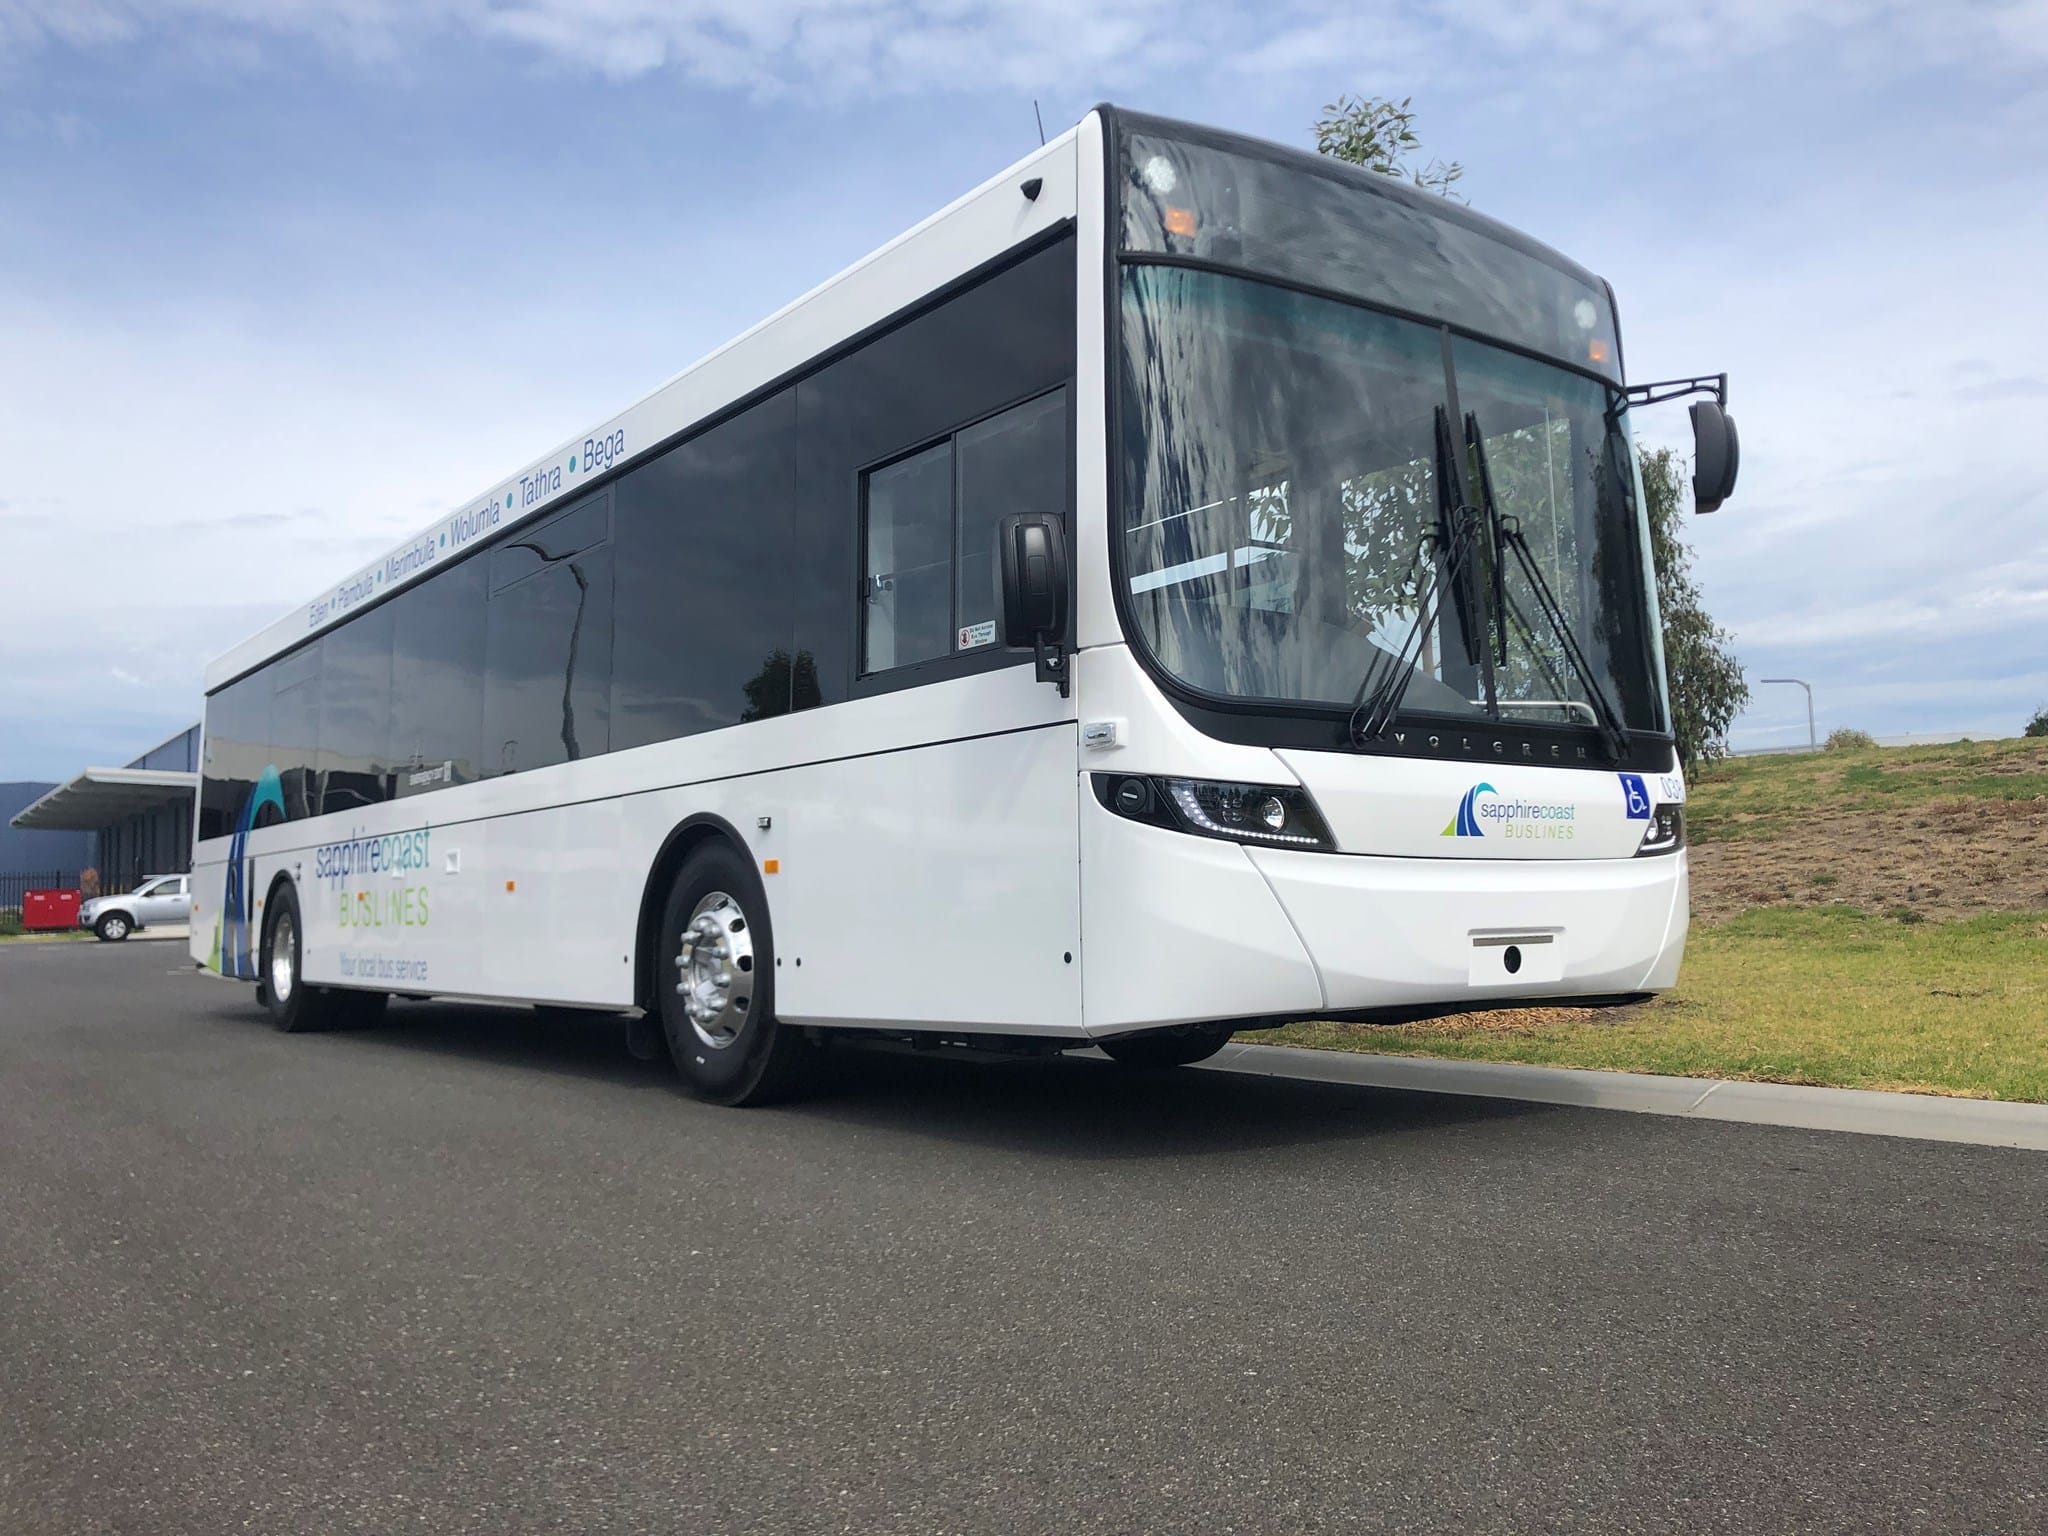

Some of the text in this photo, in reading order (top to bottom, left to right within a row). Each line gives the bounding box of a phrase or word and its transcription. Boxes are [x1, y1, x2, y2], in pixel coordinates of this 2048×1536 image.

[309, 602, 328, 627] Eden
[385, 536, 435, 584] Merimbula
[450, 498, 500, 547] Wolumla
[519, 464, 561, 508] Tathra
[583, 428, 625, 474] Bega
[1394, 732, 1587, 759] VOLGREN
[1481, 800, 1576, 822] sapphirecoast
[1504, 824, 1574, 840] BUSLINES
[316, 821, 431, 891] sapphirecoast
[340, 887, 429, 926] BUSLINES
[340, 952, 355, 976] Your
[396, 956, 427, 980] service
